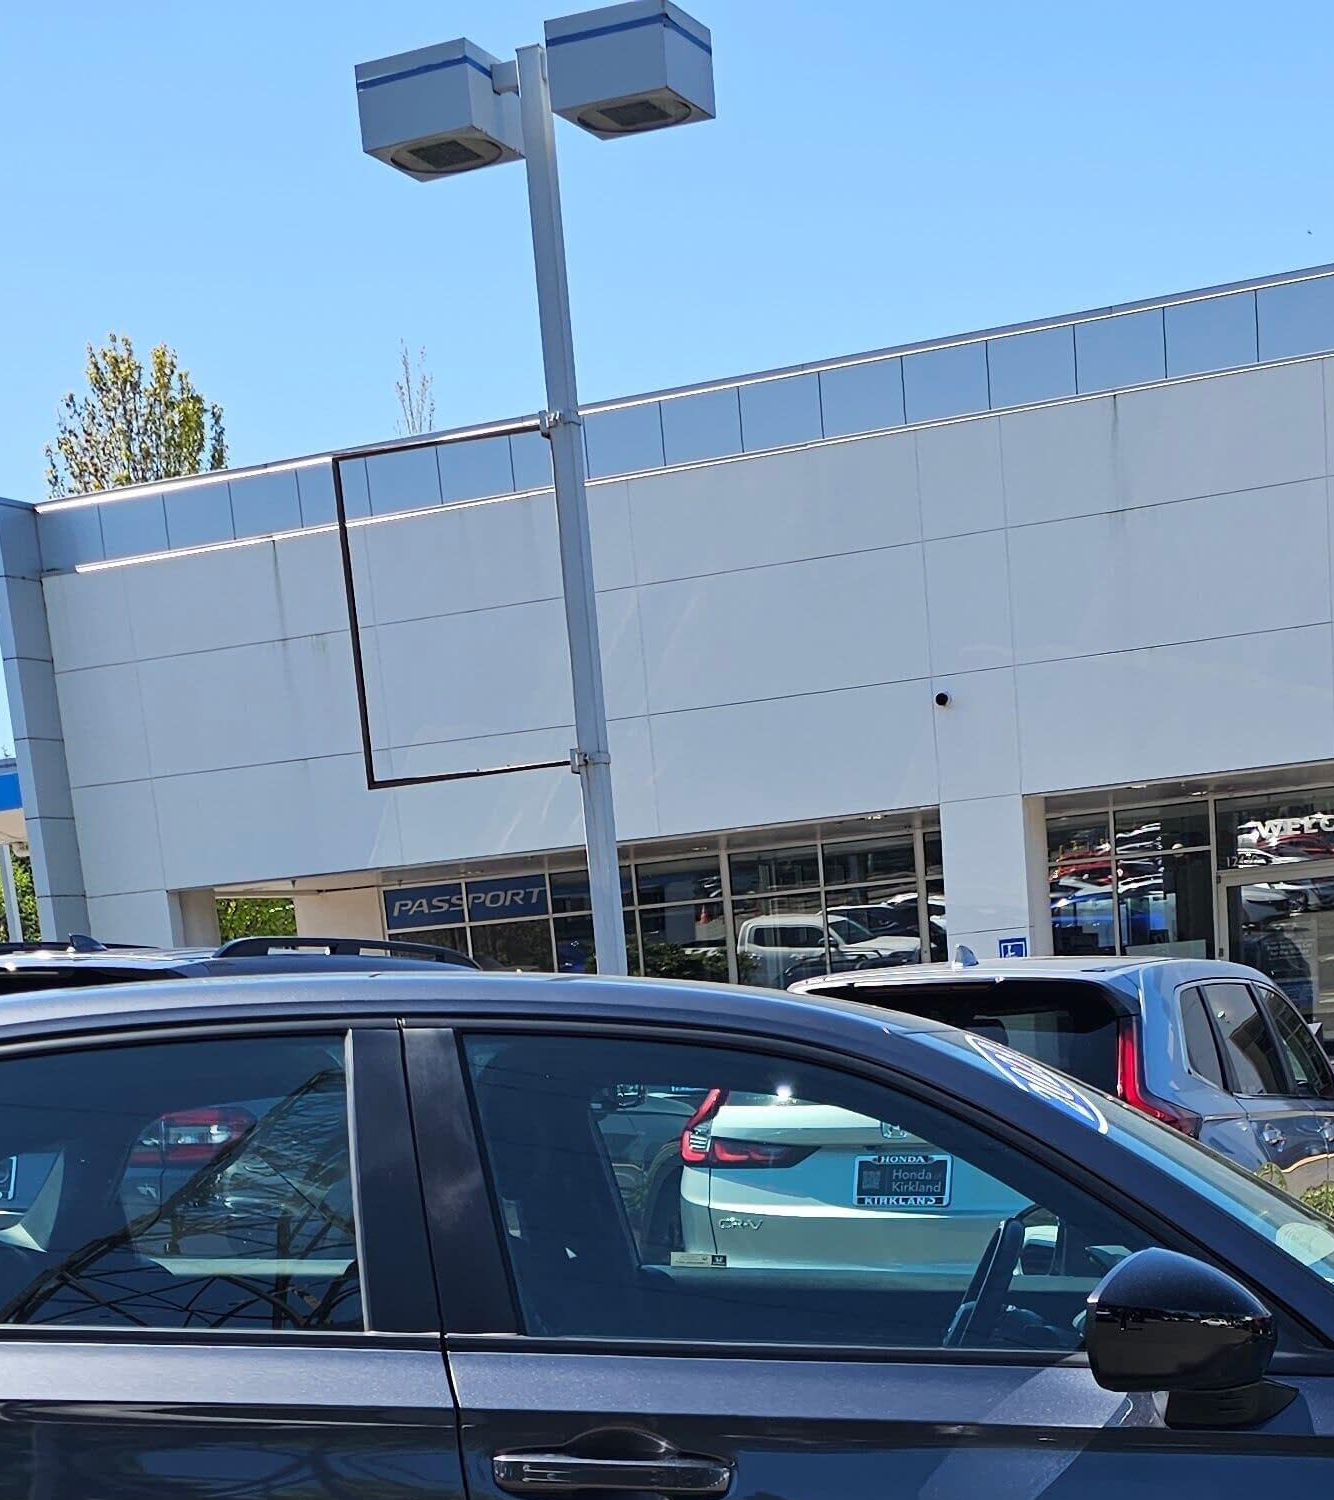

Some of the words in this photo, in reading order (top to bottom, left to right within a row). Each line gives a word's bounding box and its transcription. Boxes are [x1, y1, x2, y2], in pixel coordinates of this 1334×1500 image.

[392, 886, 547, 917] PASSPORT
[880, 1155, 926, 1164] HONDA
[892, 1169, 932, 1180] Honda
[891, 1181, 942, 1193] Kirkland
[864, 1196, 936, 1206] KIRKLAND
